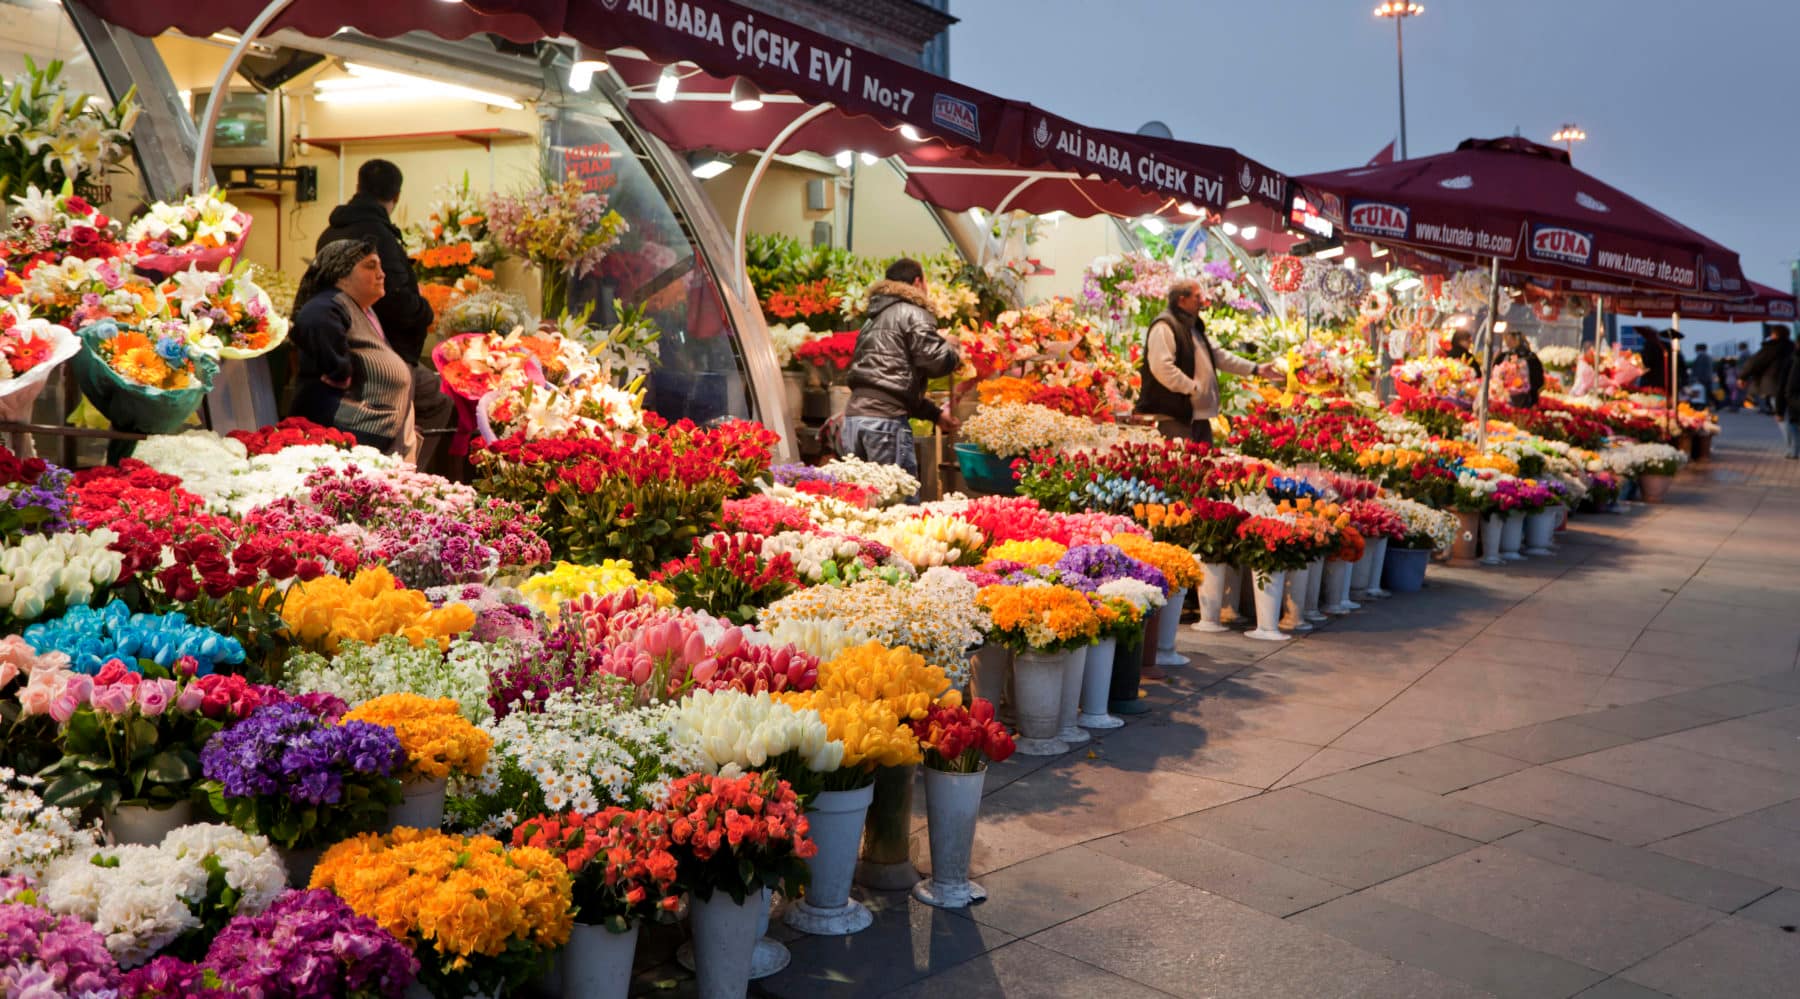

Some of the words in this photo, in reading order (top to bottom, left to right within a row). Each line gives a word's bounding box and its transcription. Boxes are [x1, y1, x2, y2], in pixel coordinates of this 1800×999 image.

[664, 0, 724, 47] BABA
[731, 14, 801, 75] ÇİÇEK
[808, 47, 852, 93] EVİ
[862, 75, 915, 115] No:7
[937, 100, 973, 124] TUNA
[1055, 129, 1082, 157] ALİ
[1086, 139, 1133, 175] BABA
[1137, 152, 1188, 194] ÇİÇEK
[1193, 175, 1223, 206] EVİ
[1258, 173, 1281, 201] ALİ
[1353, 206, 1405, 229] TUNA
[1535, 231, 1588, 257] TUNA
